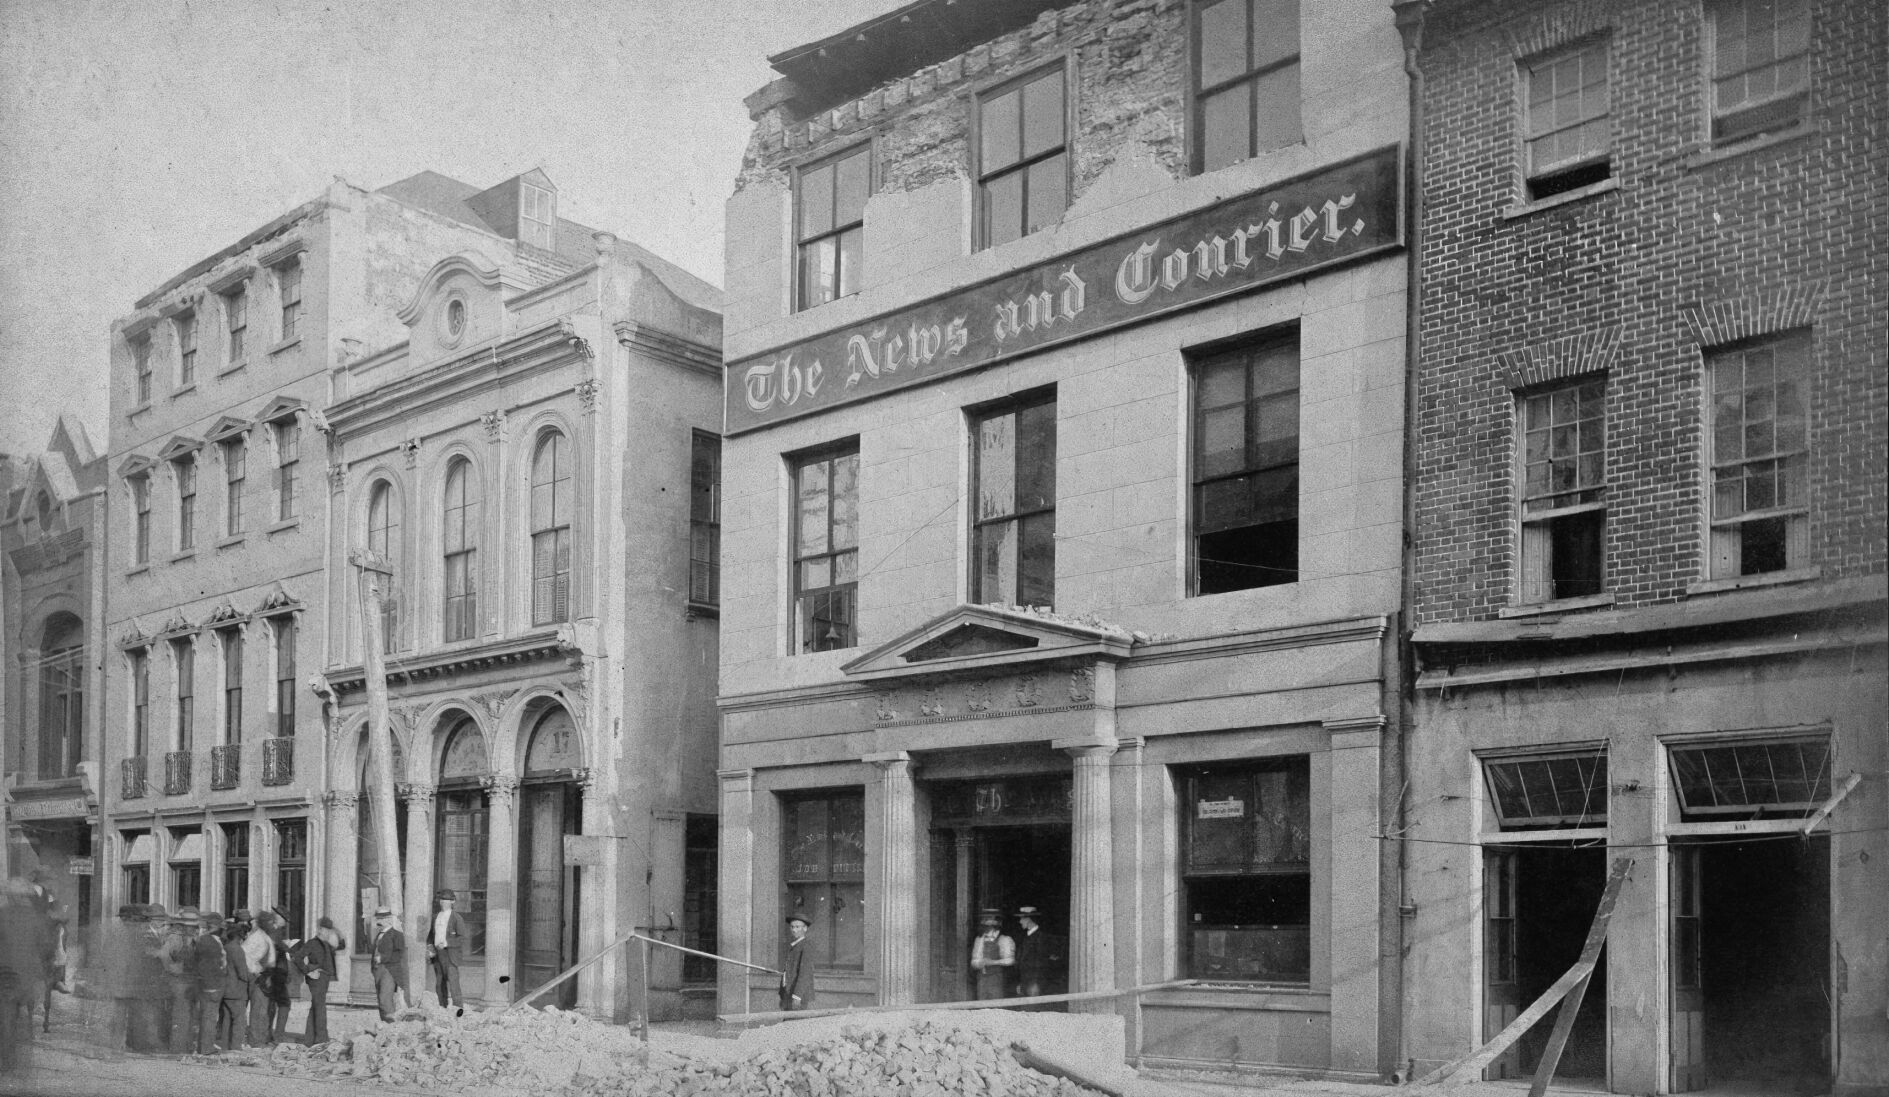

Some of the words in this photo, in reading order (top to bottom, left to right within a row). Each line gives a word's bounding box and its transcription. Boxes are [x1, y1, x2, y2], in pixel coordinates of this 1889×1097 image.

[745, 355, 824, 412] The
[844, 313, 968, 389] News
[993, 263, 1087, 341] and
